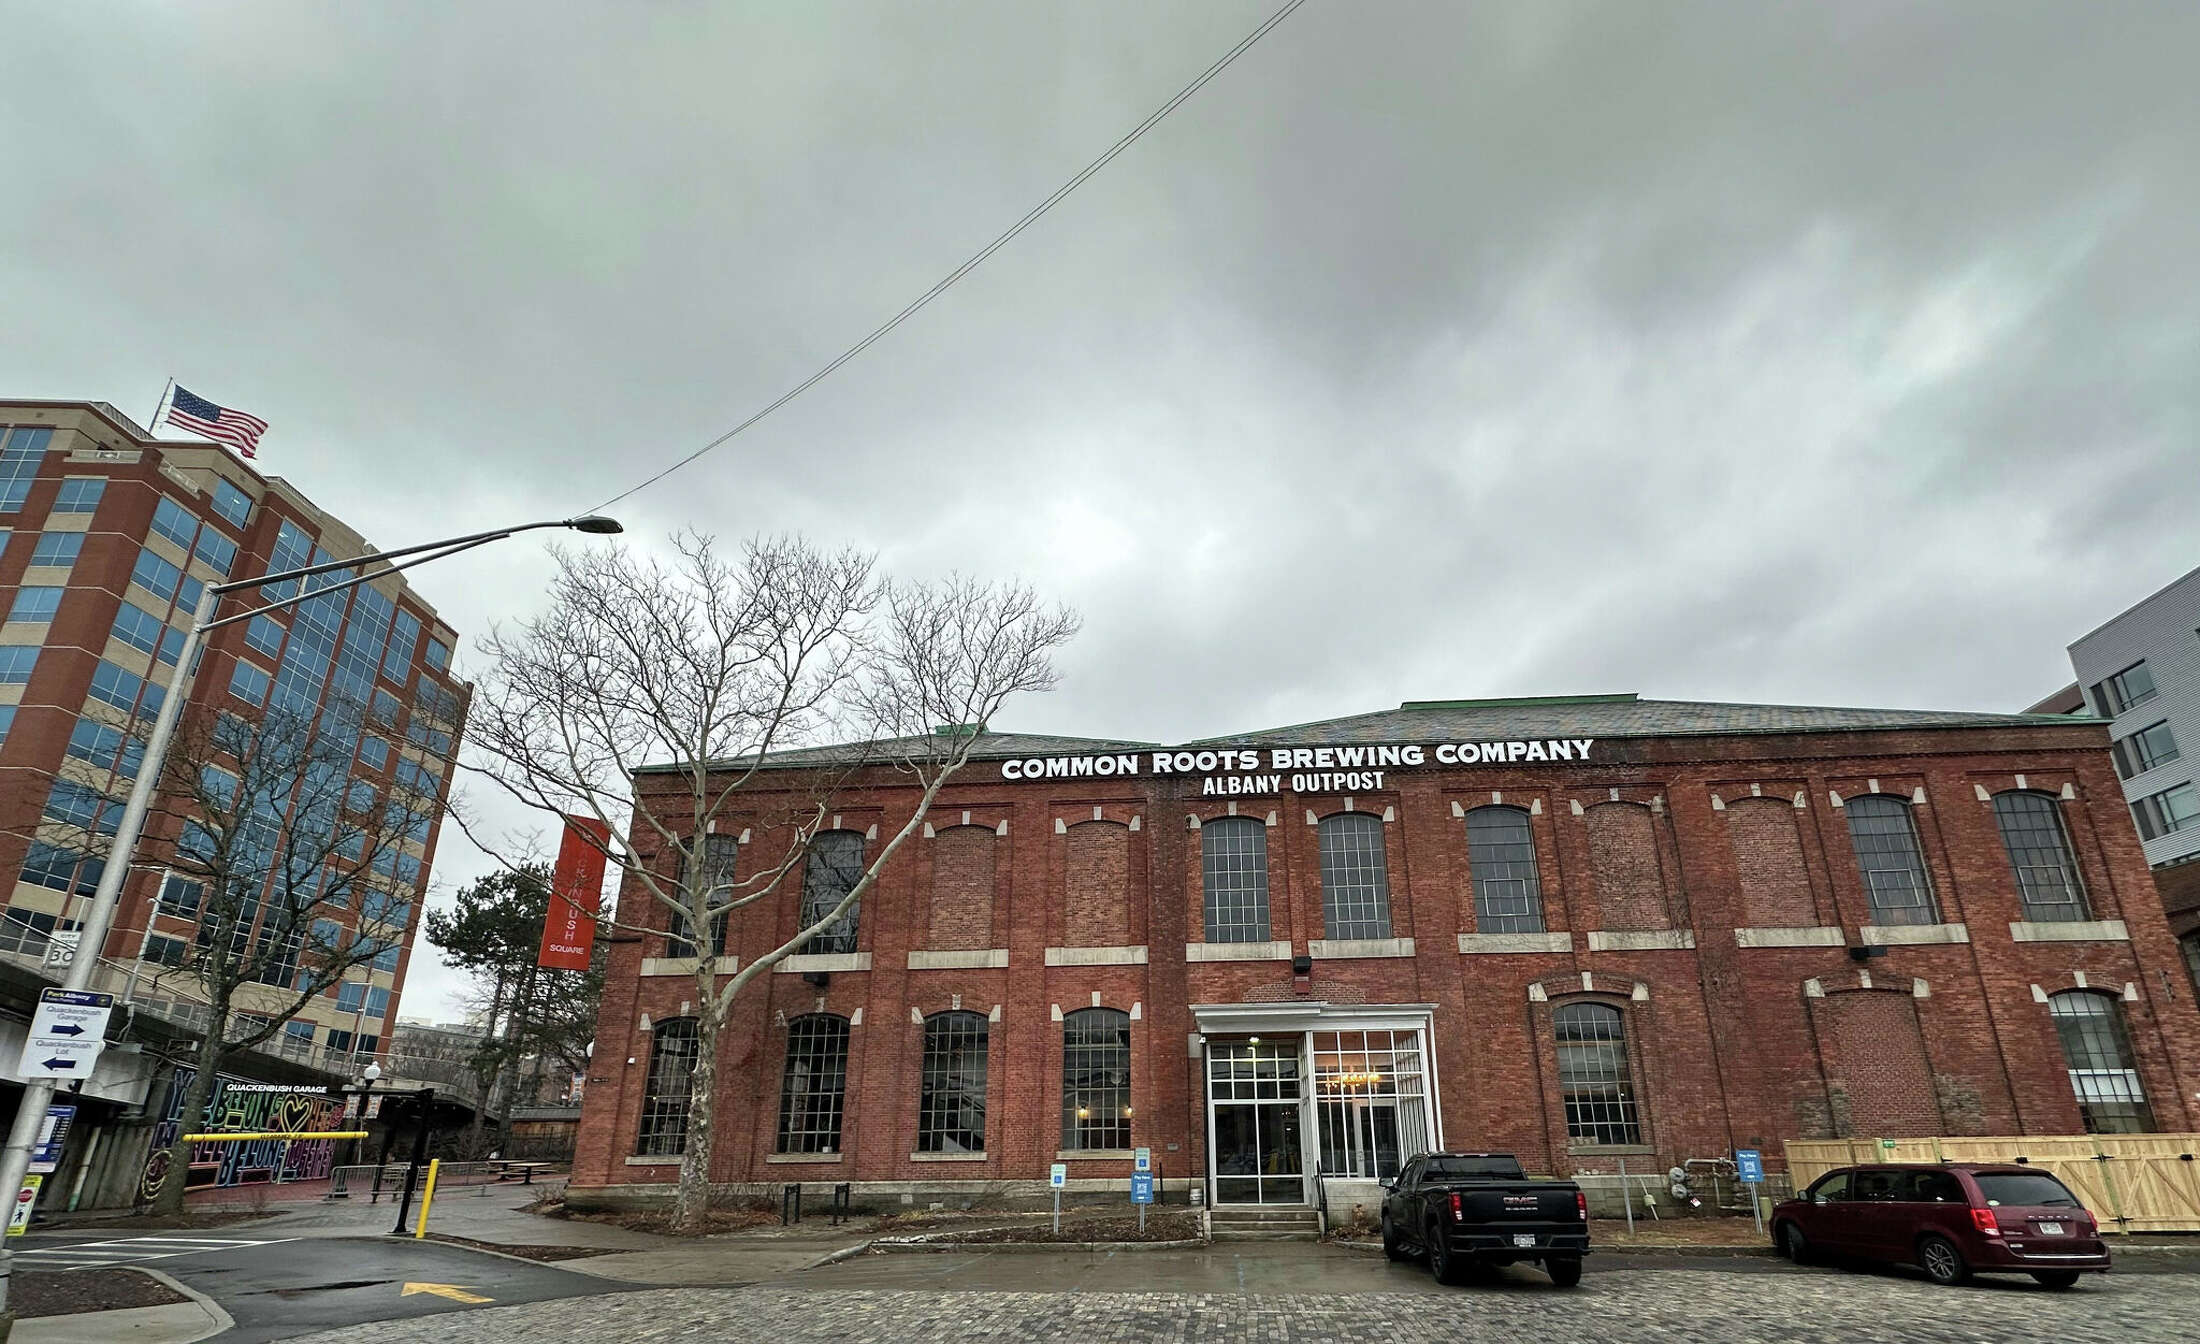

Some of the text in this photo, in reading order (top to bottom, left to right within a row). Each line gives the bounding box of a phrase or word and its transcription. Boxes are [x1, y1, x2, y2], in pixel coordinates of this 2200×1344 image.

[1001, 739, 1594, 779] COMMON ROOTS BREWING COMPANY
[1202, 771, 1384, 795] ALBANY OUTPOST
[549, 944, 584, 955] SQUARE
[50, 950, 74, 962] 30
[46, 1005, 101, 1016] Quackenbush
[57, 1013, 88, 1022] Garage
[35, 1040, 92, 1049] Quackenbush
[227, 1083, 328, 1094] QUACKENBUSH GARAGE
